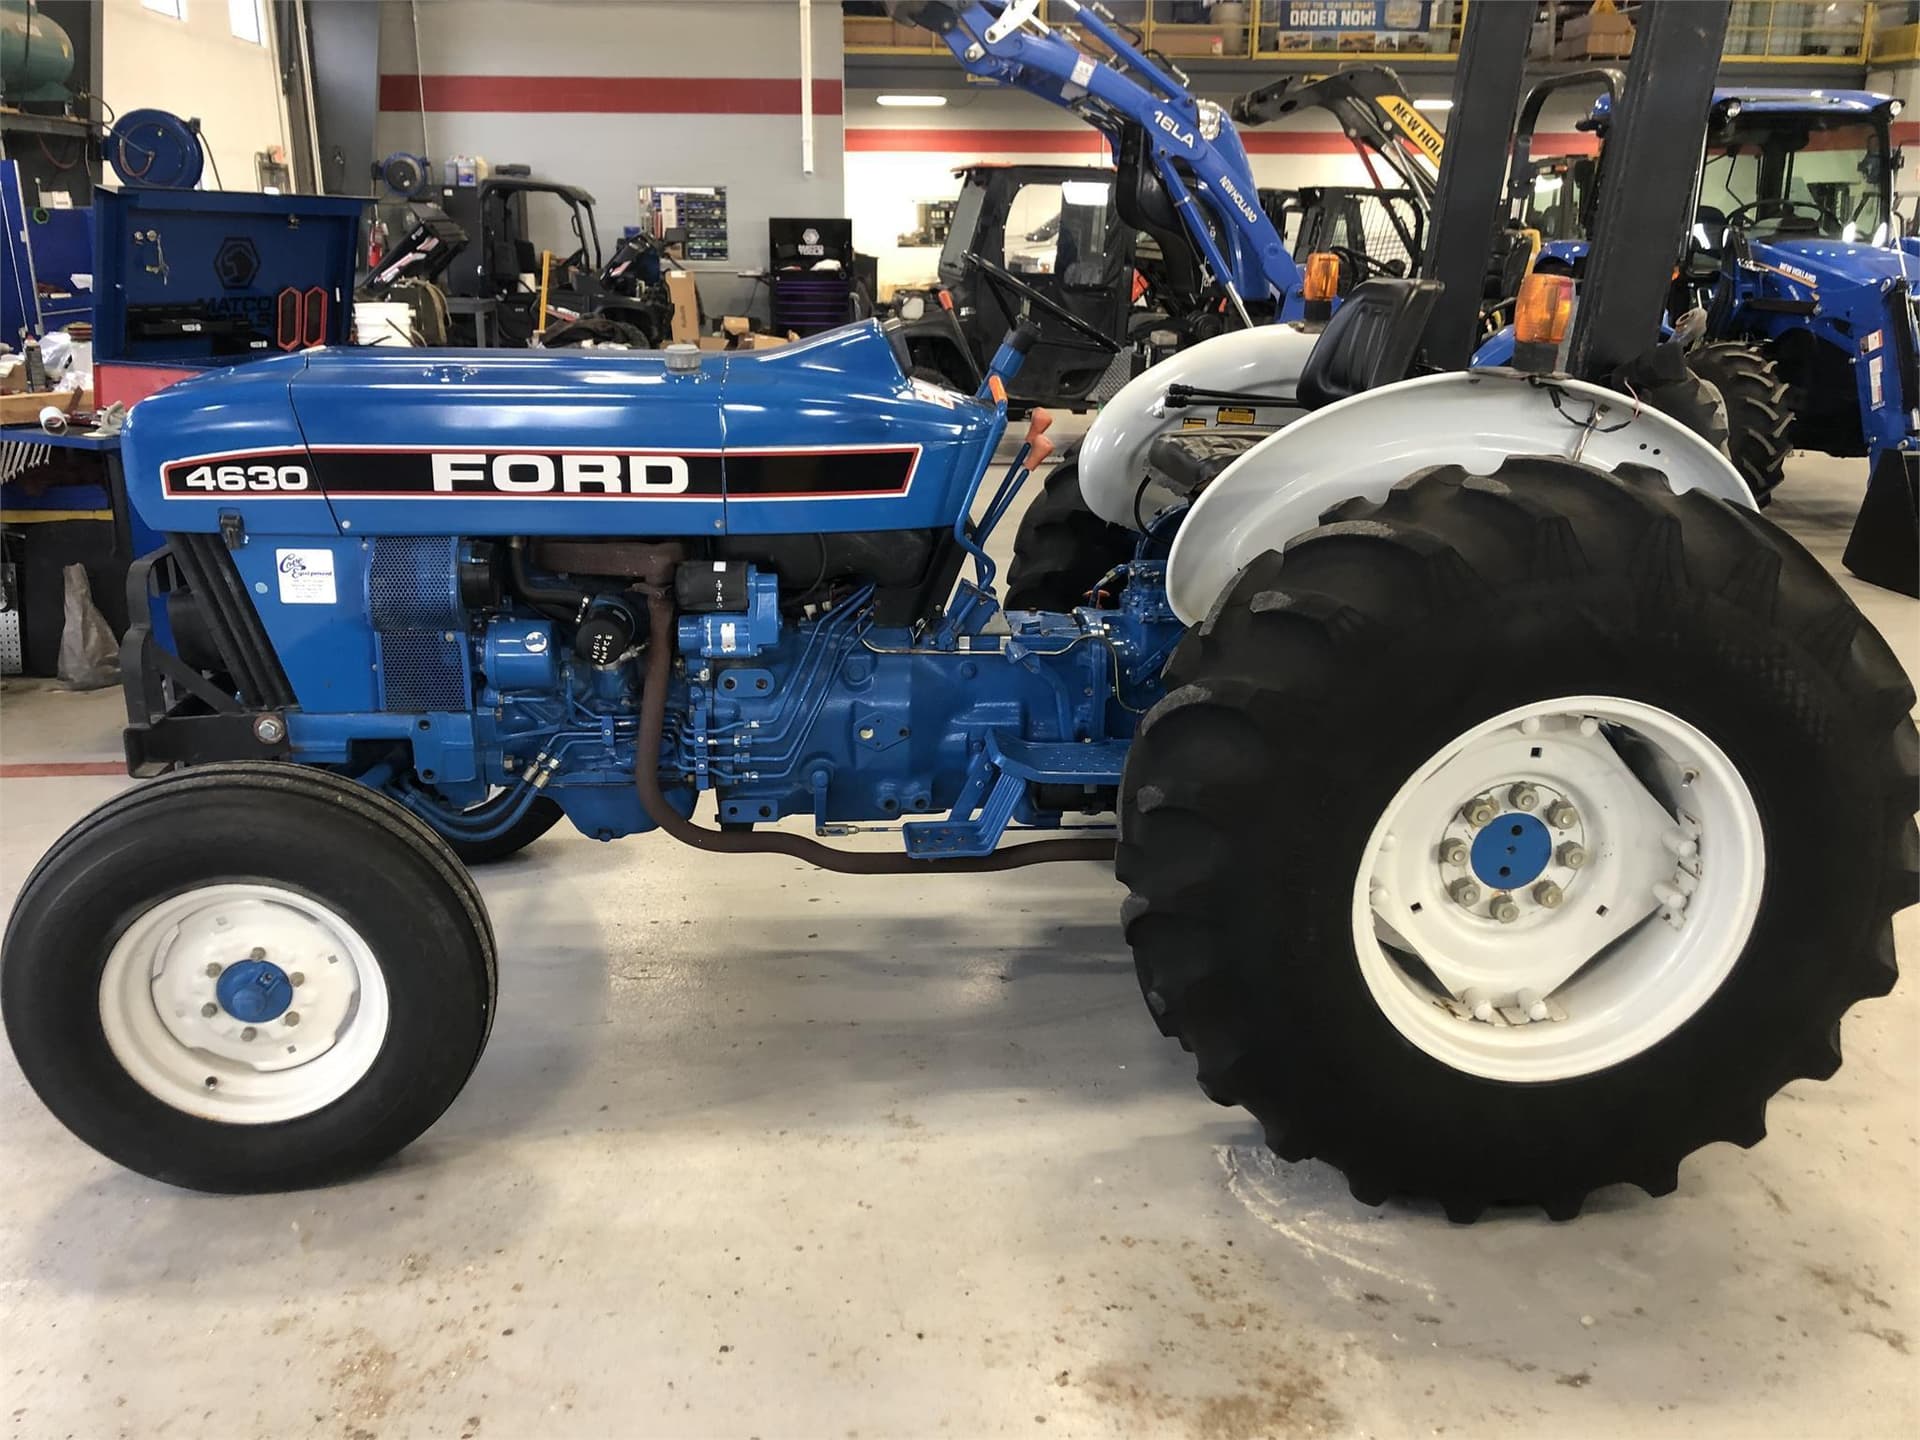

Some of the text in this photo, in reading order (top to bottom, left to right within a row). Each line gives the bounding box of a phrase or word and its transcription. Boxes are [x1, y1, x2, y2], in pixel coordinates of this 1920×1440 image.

[1290, 9, 1337, 26] ORDER
[1340, 9, 1377, 26] NOW!
[1153, 110, 1194, 149] 16LA
[1392, 102, 1421, 132] NEW
[1219, 175, 1257, 223] NEW HOLLAND
[186, 466, 308, 490] 4630
[431, 453, 690, 494] FORD
